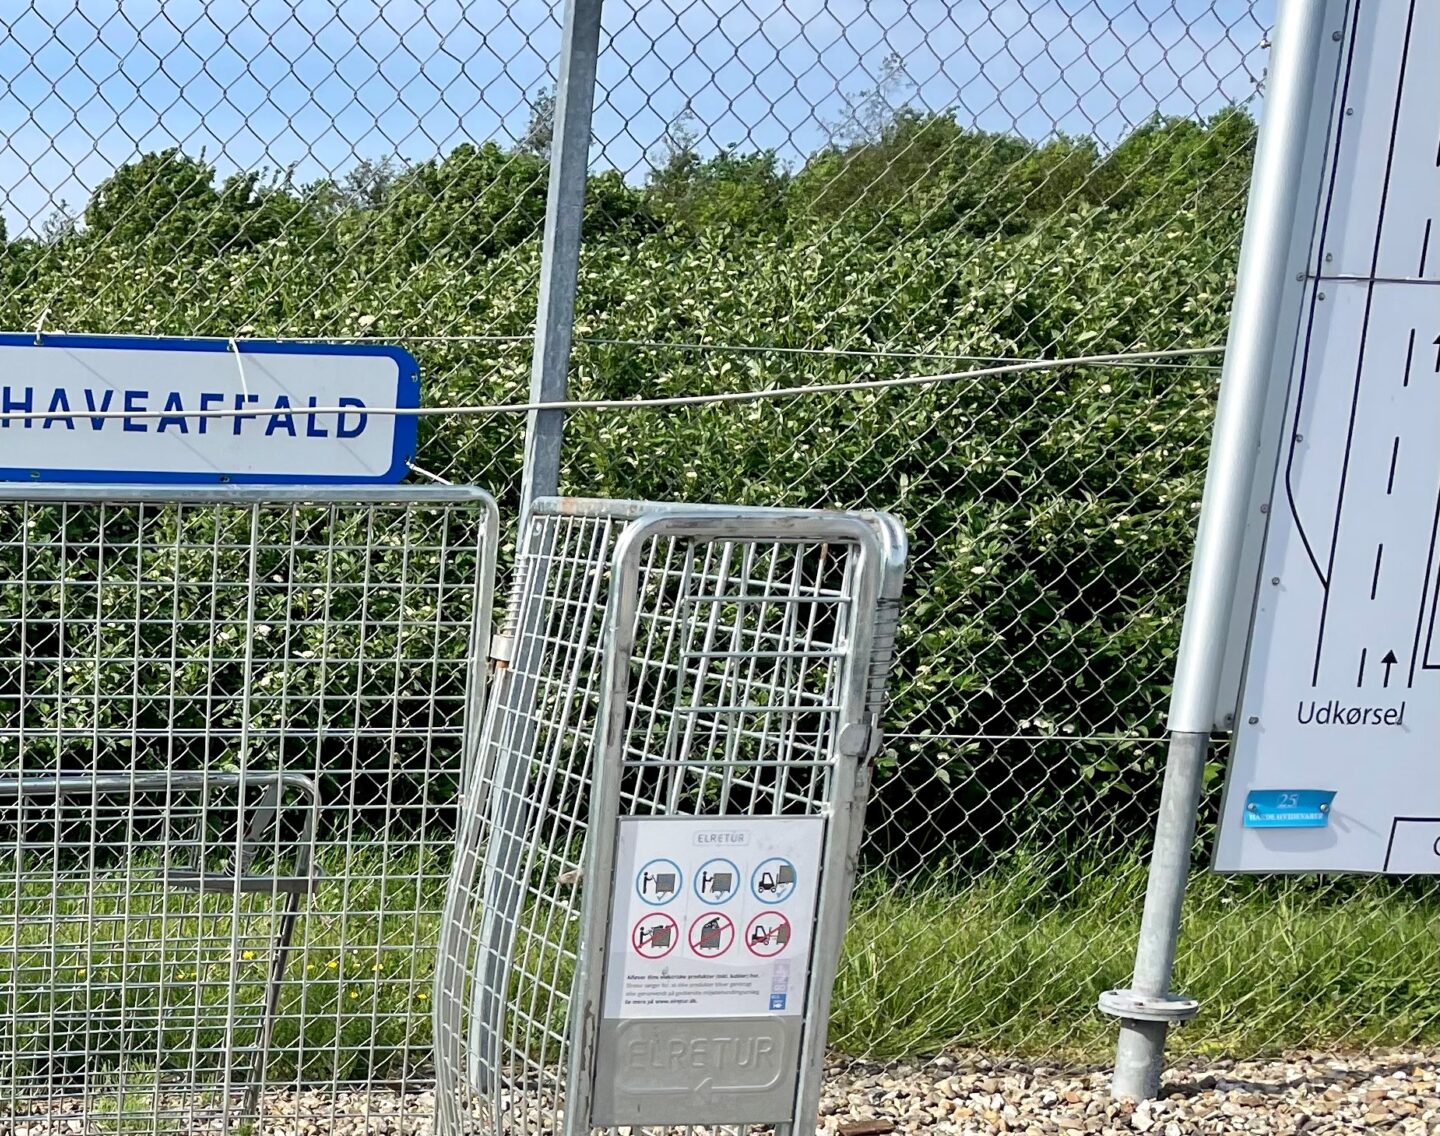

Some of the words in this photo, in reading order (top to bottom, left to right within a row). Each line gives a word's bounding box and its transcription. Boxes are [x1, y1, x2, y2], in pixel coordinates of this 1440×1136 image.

[1, 385, 369, 439] HAVEAFFALD
[1297, 700, 1406, 726] Udkørsel
[697, 833, 745, 843] ELRETUR
[627, 1035, 775, 1069] ELRETUR
